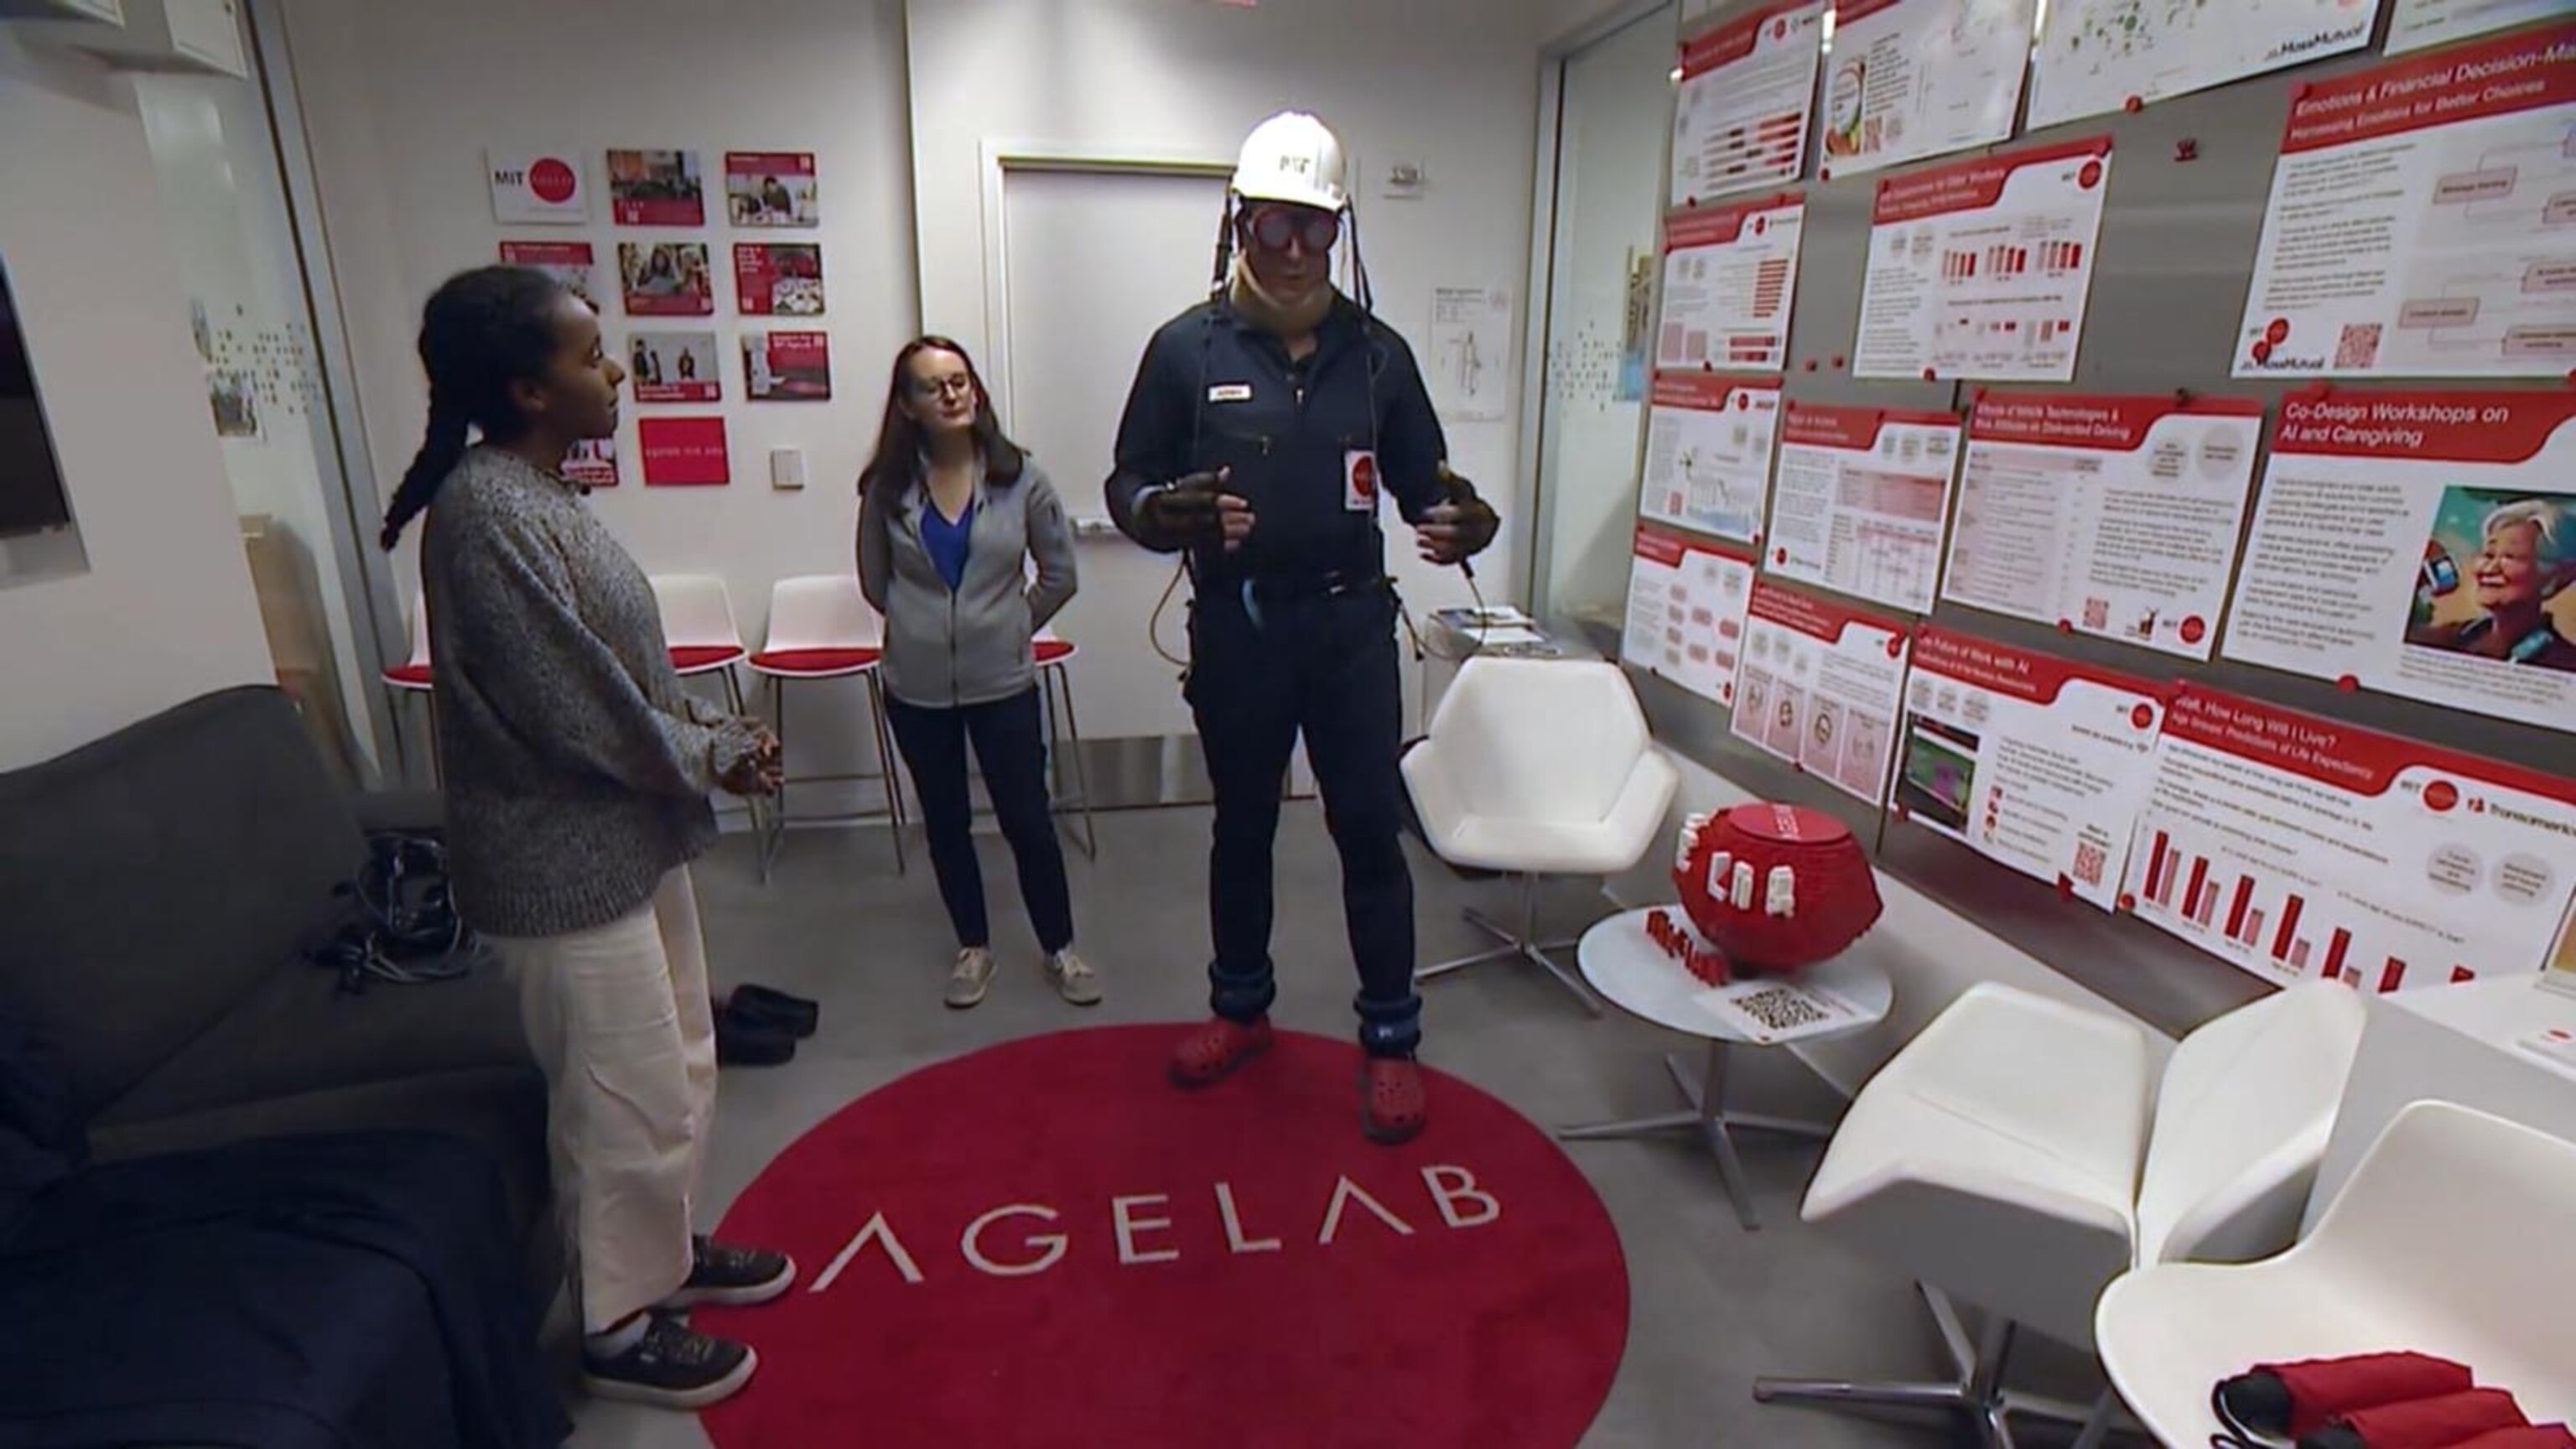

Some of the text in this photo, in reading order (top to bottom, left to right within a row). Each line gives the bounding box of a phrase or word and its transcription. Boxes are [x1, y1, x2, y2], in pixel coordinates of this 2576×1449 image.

[2296, 90, 2361, 116] Emotions
[2366, 86, 2377, 101] &
[2381, 70, 2452, 99] Financial
[2356, 106, 2411, 127] Emotions
[2412, 101, 2433, 114] for
[2436, 92, 2480, 111] Better
[2482, 80, 2545, 101] Choices
[495, 170, 523, 186] MIT
[2047, 405, 2109, 424] Technologies
[2286, 402, 2509, 424] Co-Design Workshops on
[2093, 423, 2131, 441] Driving
[2279, 424, 2423, 448] AI and Caregiving
[2205, 699, 2231, 719] How
[2232, 708, 2264, 733] Long
[2266, 719, 2289, 737] Will
[2298, 725, 2338, 748] Live?
[808, 1164, 1502, 1293] AGELAB
